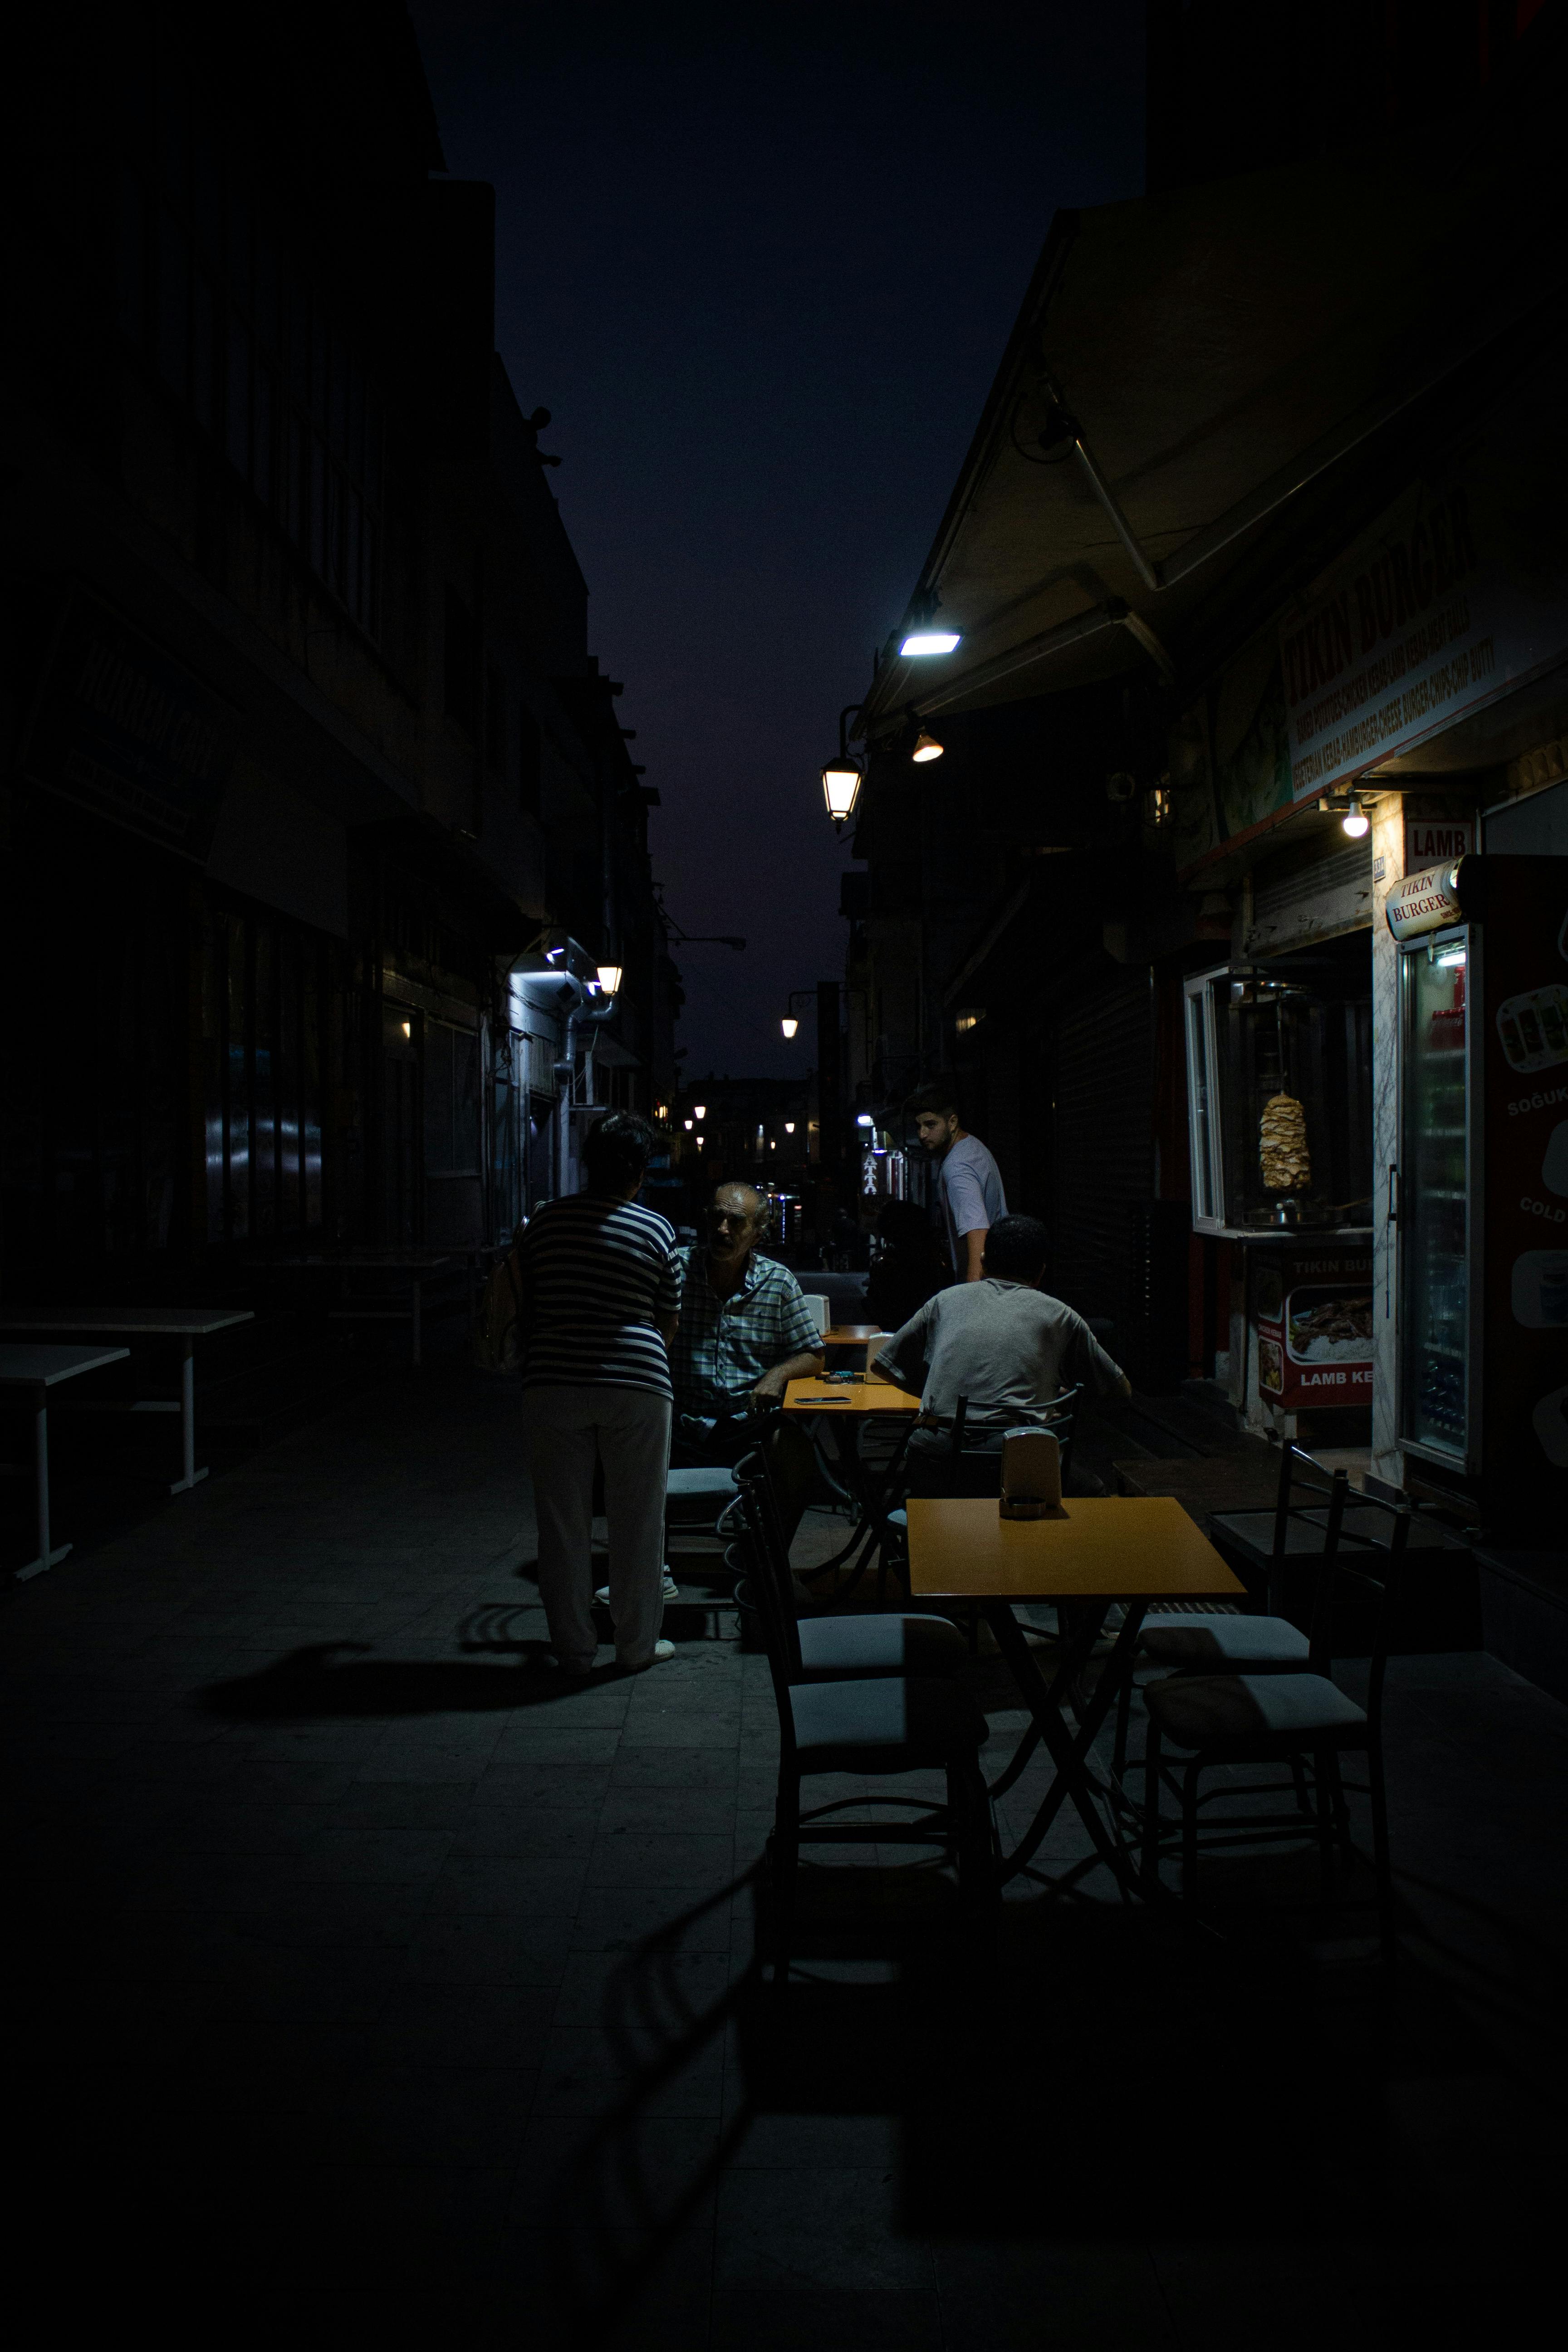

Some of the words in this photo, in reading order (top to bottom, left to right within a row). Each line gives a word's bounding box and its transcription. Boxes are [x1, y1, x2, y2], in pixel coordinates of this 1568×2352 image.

[1355, 485, 1478, 655] BURGER
[1469, 634, 1496, 682] BUTTY
[1414, 830, 1465, 856] LAMB
[1401, 873, 1436, 898] TIKIN
[1392, 893, 1450, 922] BURGER
[1507, 1087, 1568, 1116] SOĞUK
[1520, 1197, 1566, 1223] COLD
[1293, 1260, 1339, 1273] TIKIN
[1300, 1372, 1347, 1386] LAMB
